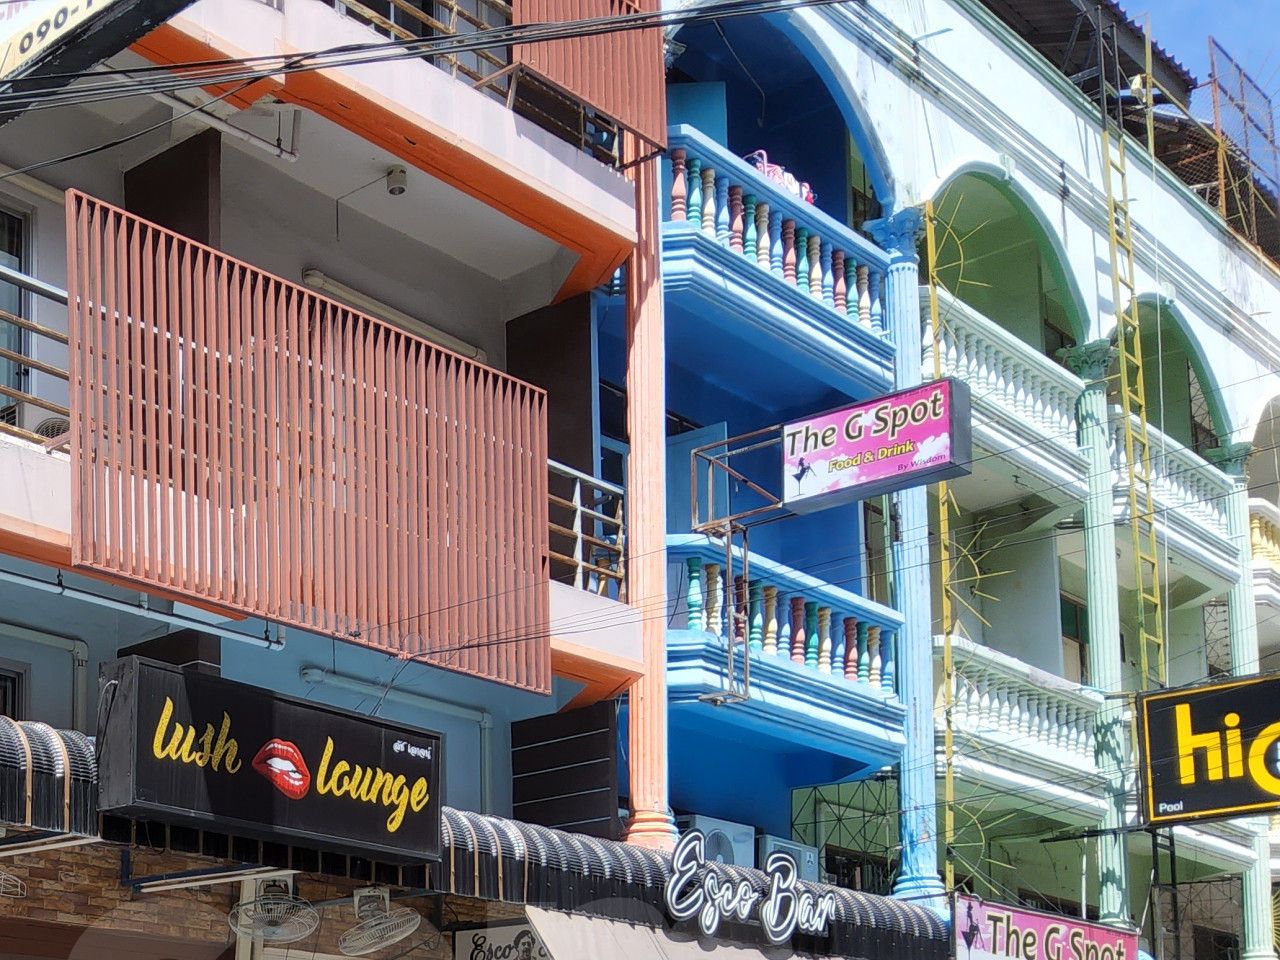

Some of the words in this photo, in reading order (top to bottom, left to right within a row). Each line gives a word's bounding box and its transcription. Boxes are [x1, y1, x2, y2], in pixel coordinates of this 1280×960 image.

[785, 425, 837, 457] The
[844, 411, 866, 443] G
[872, 389, 944, 441] Spot
[828, 453, 861, 473] Food
[863, 451, 875, 464] &
[878, 440, 915, 459] Drink
[897, 462, 909, 472] By
[911, 453, 947, 468] Wisdom
[152, 696, 242, 774] lush
[316, 735, 430, 833] lounge
[1159, 801, 1184, 813] Pool
[666, 828, 759, 938] Esco
[760, 850, 836, 945] Bar
